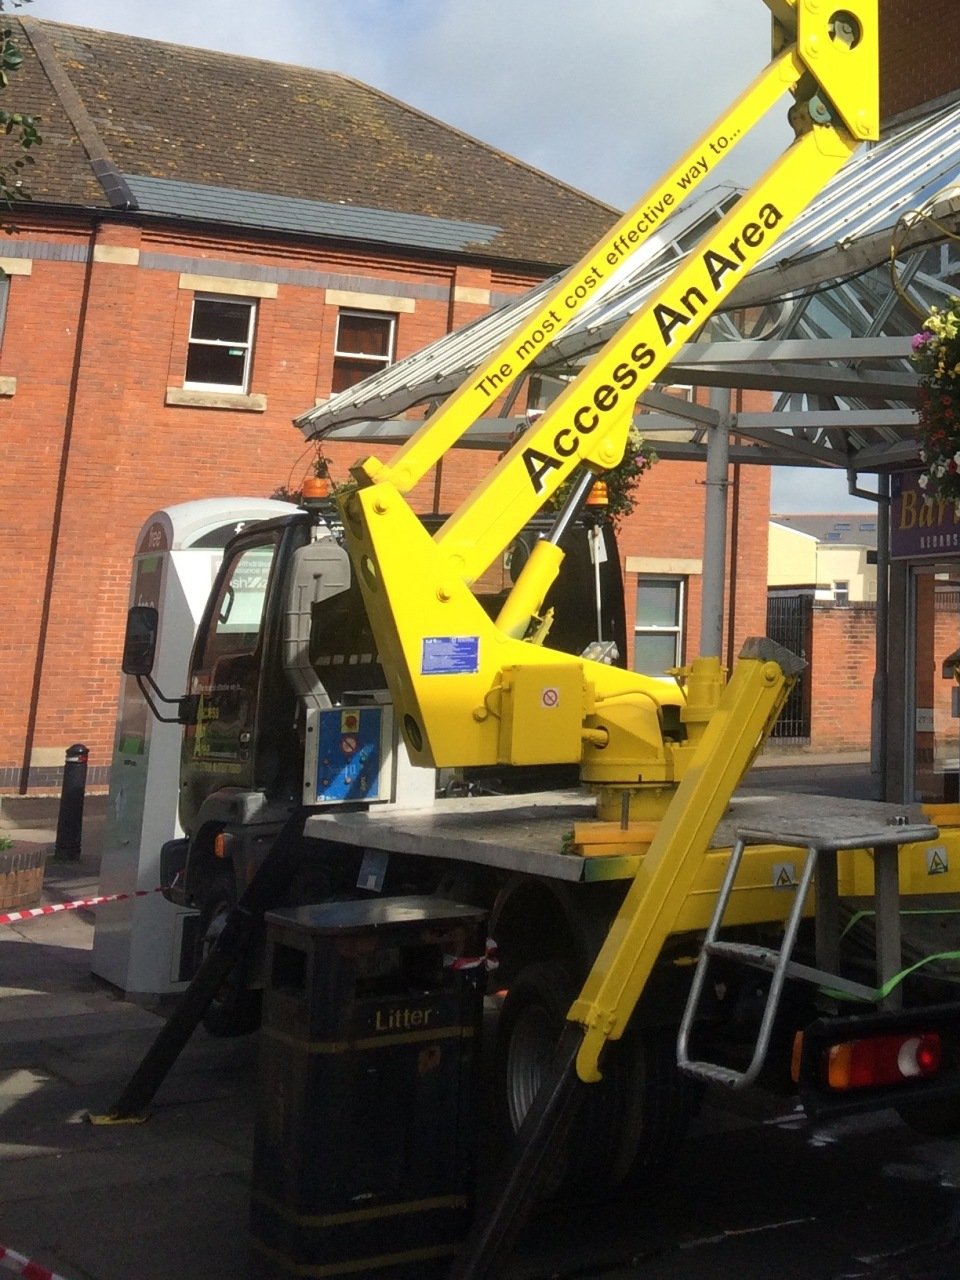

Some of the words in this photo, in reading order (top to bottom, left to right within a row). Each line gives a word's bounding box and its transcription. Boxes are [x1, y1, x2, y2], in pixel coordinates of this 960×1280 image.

[475, 362, 513, 398] The
[515, 312, 563, 360] most
[566, 266, 604, 310] cost
[606, 193, 675, 266] effective
[677, 155, 709, 191] way
[521, 342, 656, 494] Access
[651, 286, 709, 345] An
[703, 202, 784, 291] Area
[376, 1007, 432, 1030] Litter
